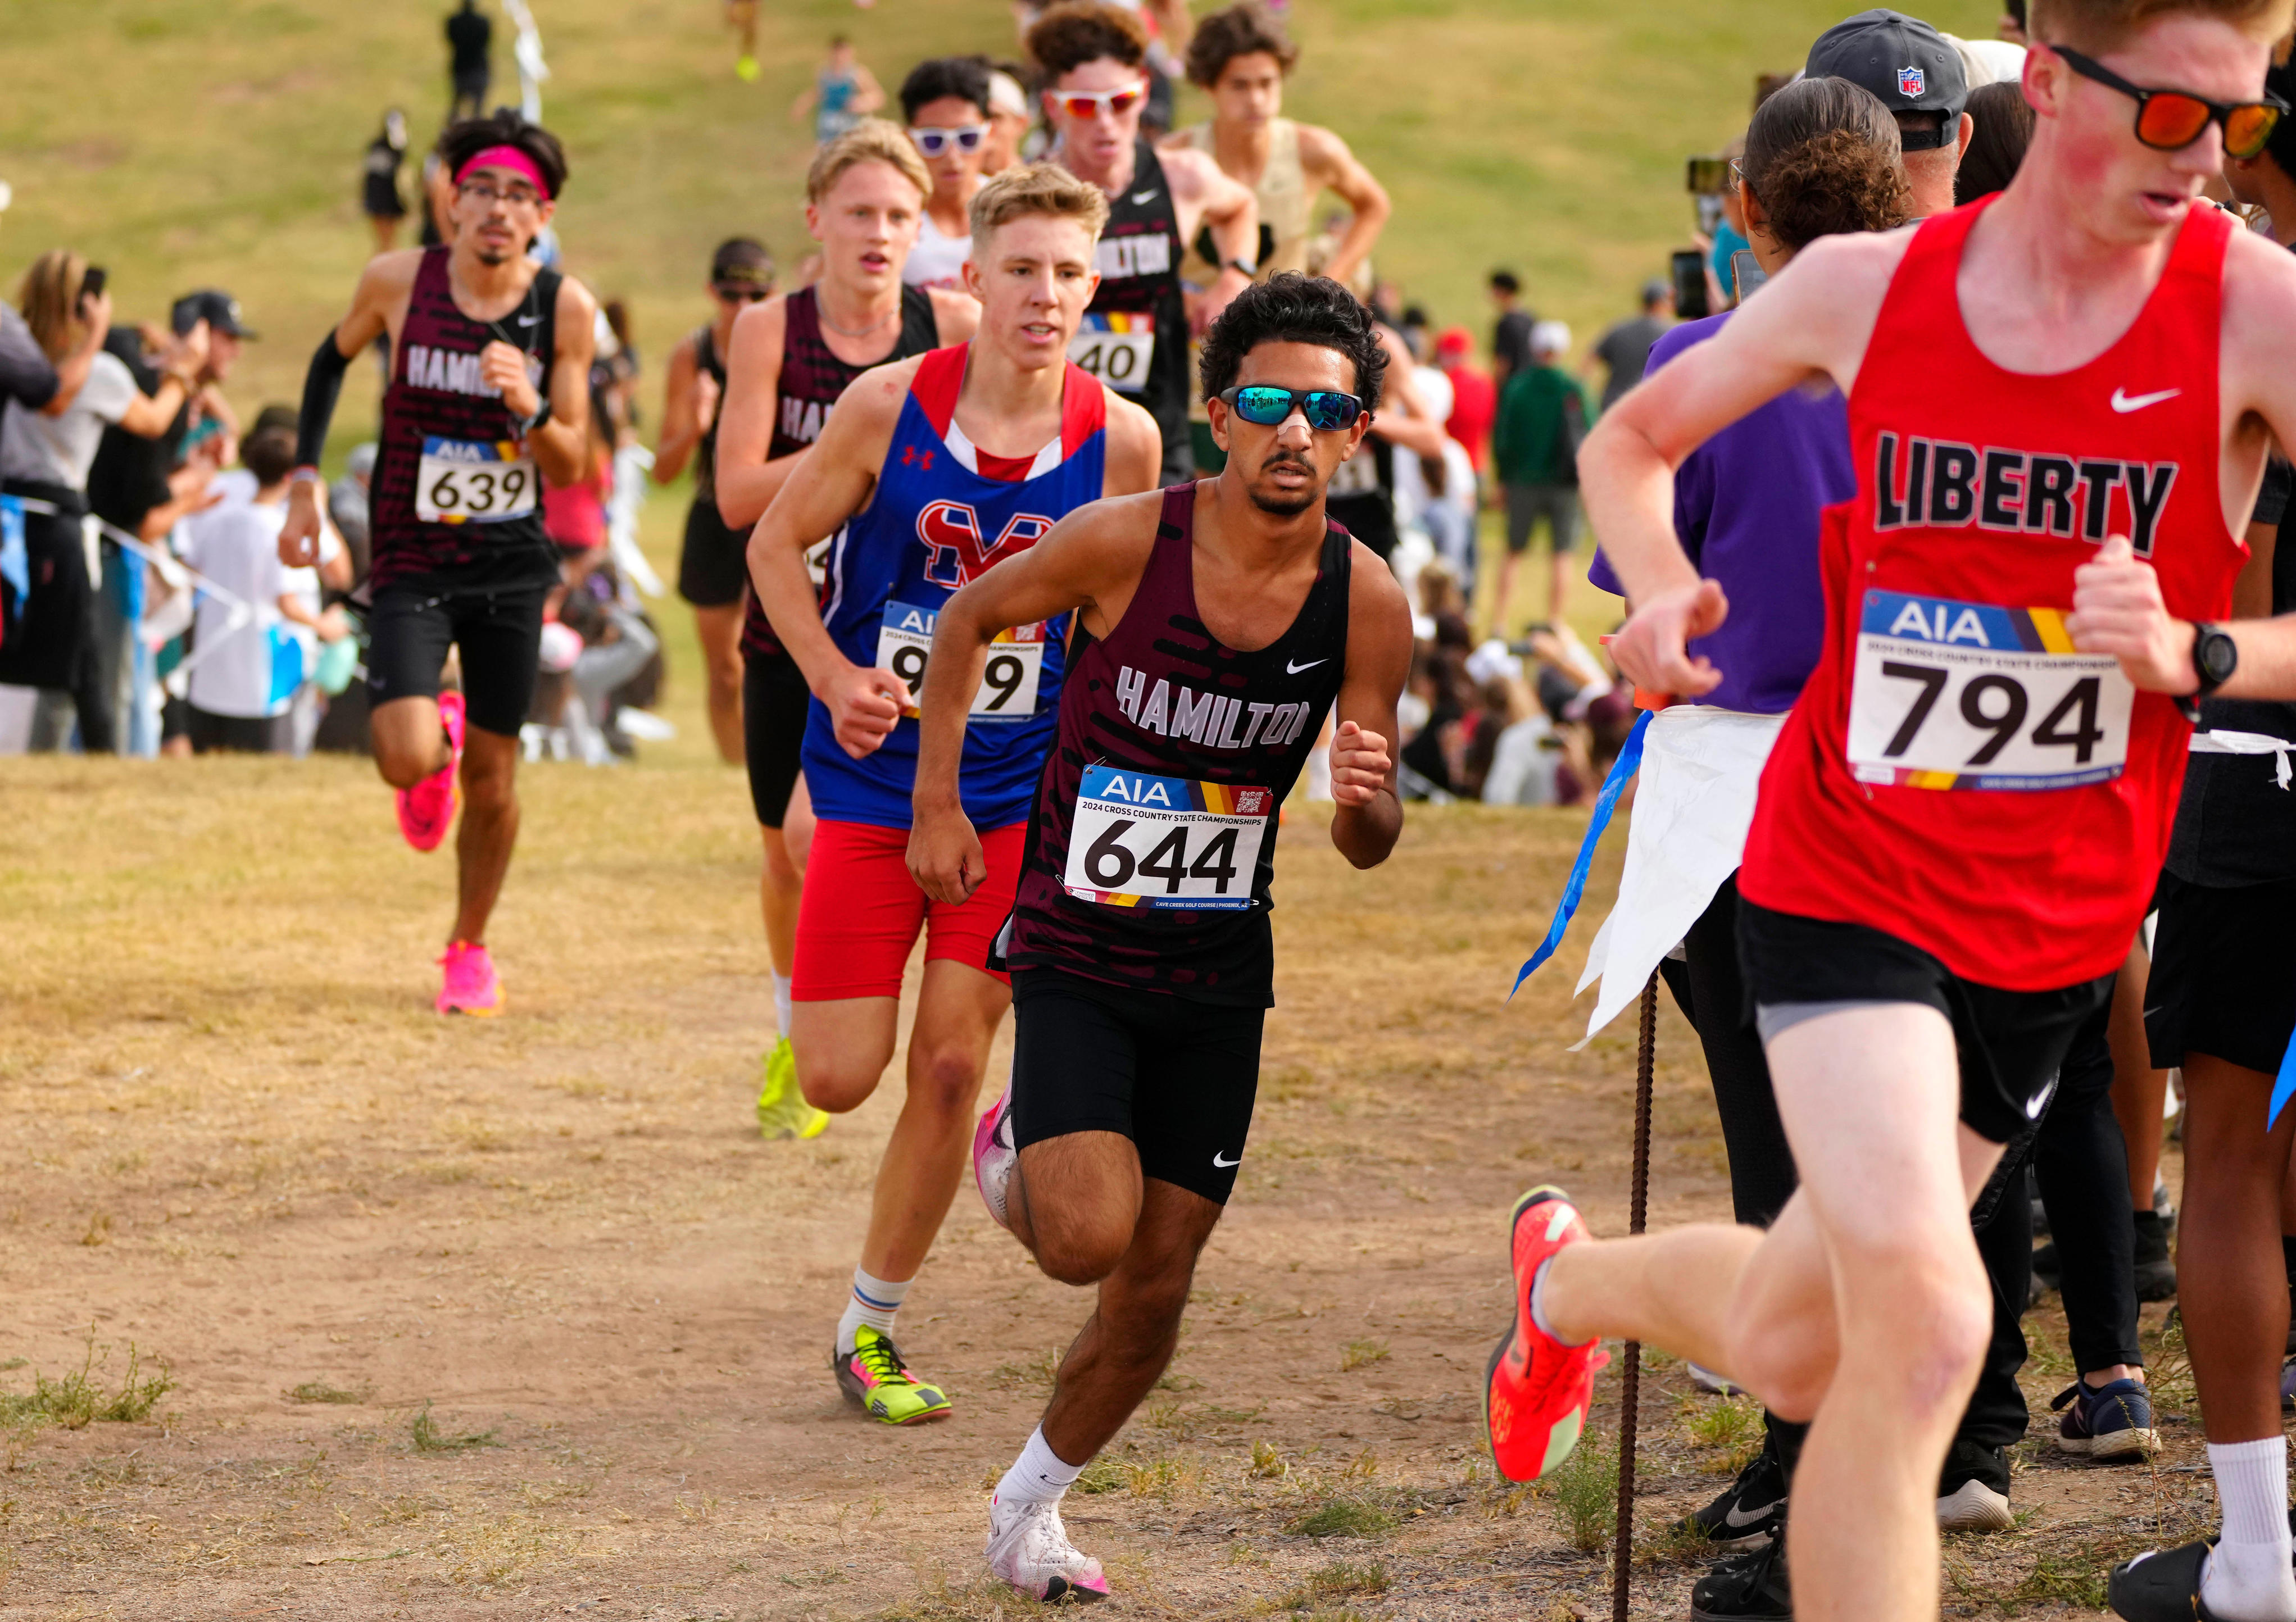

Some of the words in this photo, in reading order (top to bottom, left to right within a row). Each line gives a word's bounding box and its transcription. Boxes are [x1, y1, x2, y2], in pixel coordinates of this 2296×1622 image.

[1903, 80, 1922, 93] NFL
[1077, 343, 1135, 380] 40
[434, 440, 483, 462] AIA
[430, 469, 526, 512] 639
[1873, 430, 2180, 560] LIBERTY
[900, 610, 934, 634] AI
[1889, 600, 1991, 648] AIA
[892, 646, 1024, 711] 99
[1881, 660, 2104, 766] 794
[1100, 775, 1172, 807] AIA
[1082, 801, 1103, 811] 2024
[1105, 805, 1132, 816] CROSS
[1133, 810, 1173, 821] COUNTRY
[1197, 815, 1262, 826] CHAMPIONSHIPS
[1084, 819, 1240, 894] 644
